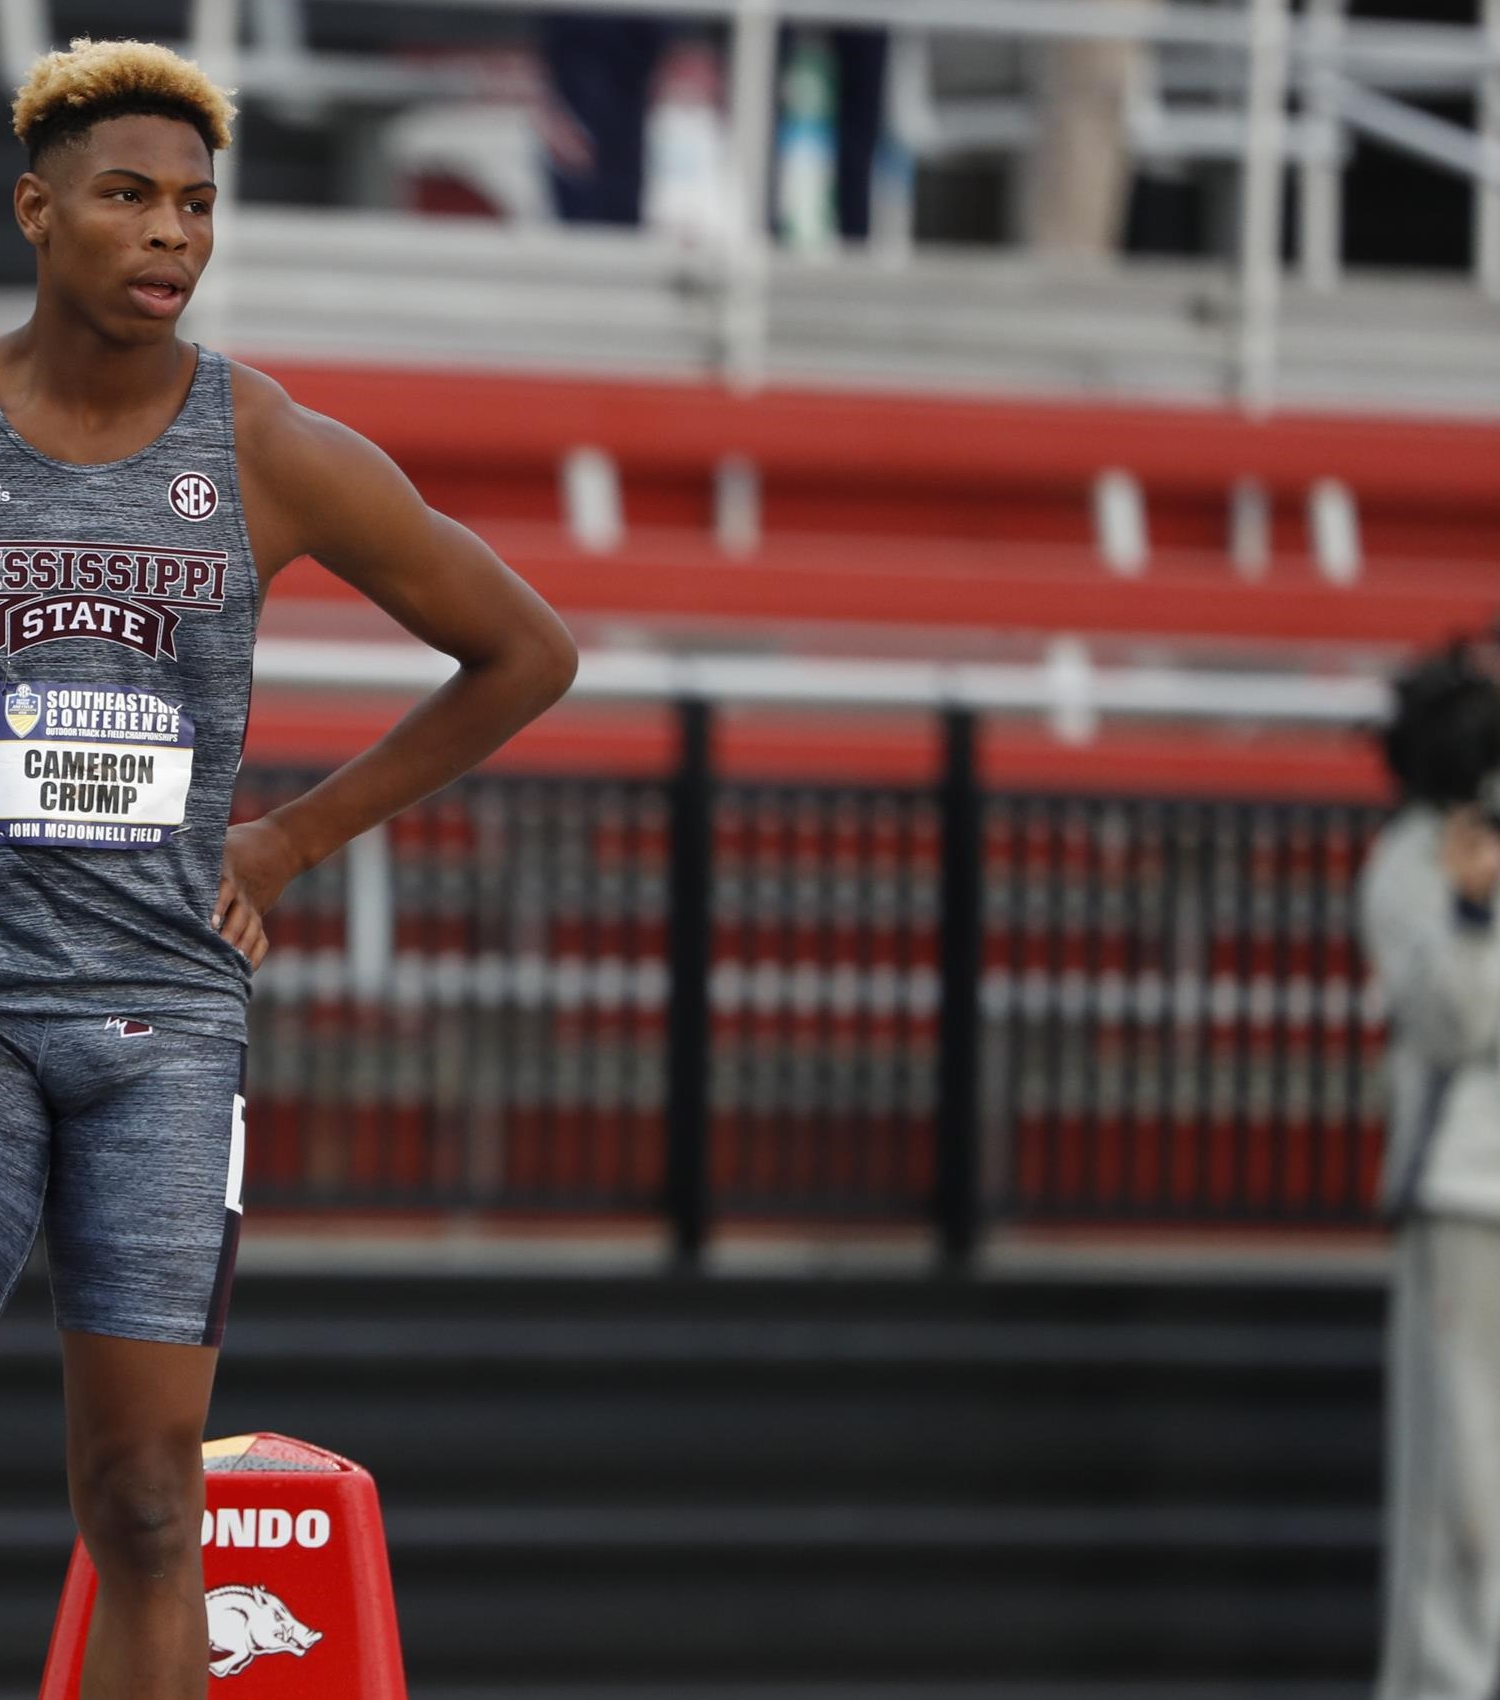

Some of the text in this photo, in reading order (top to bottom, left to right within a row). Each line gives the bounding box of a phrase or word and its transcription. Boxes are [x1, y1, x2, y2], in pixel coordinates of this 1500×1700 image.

[174, 478, 212, 516] SEC
[22, 602, 147, 644] STATE
[45, 727, 178, 742] OUTDOOR TRACK & FIELD CHAMPIONSHIPS
[46, 709, 180, 733] CONFERENCE
[24, 749, 154, 784] CAMERON
[40, 781, 137, 814] CRUMP
[9, 823, 162, 842] JOHN MCDONNELL FIELD
